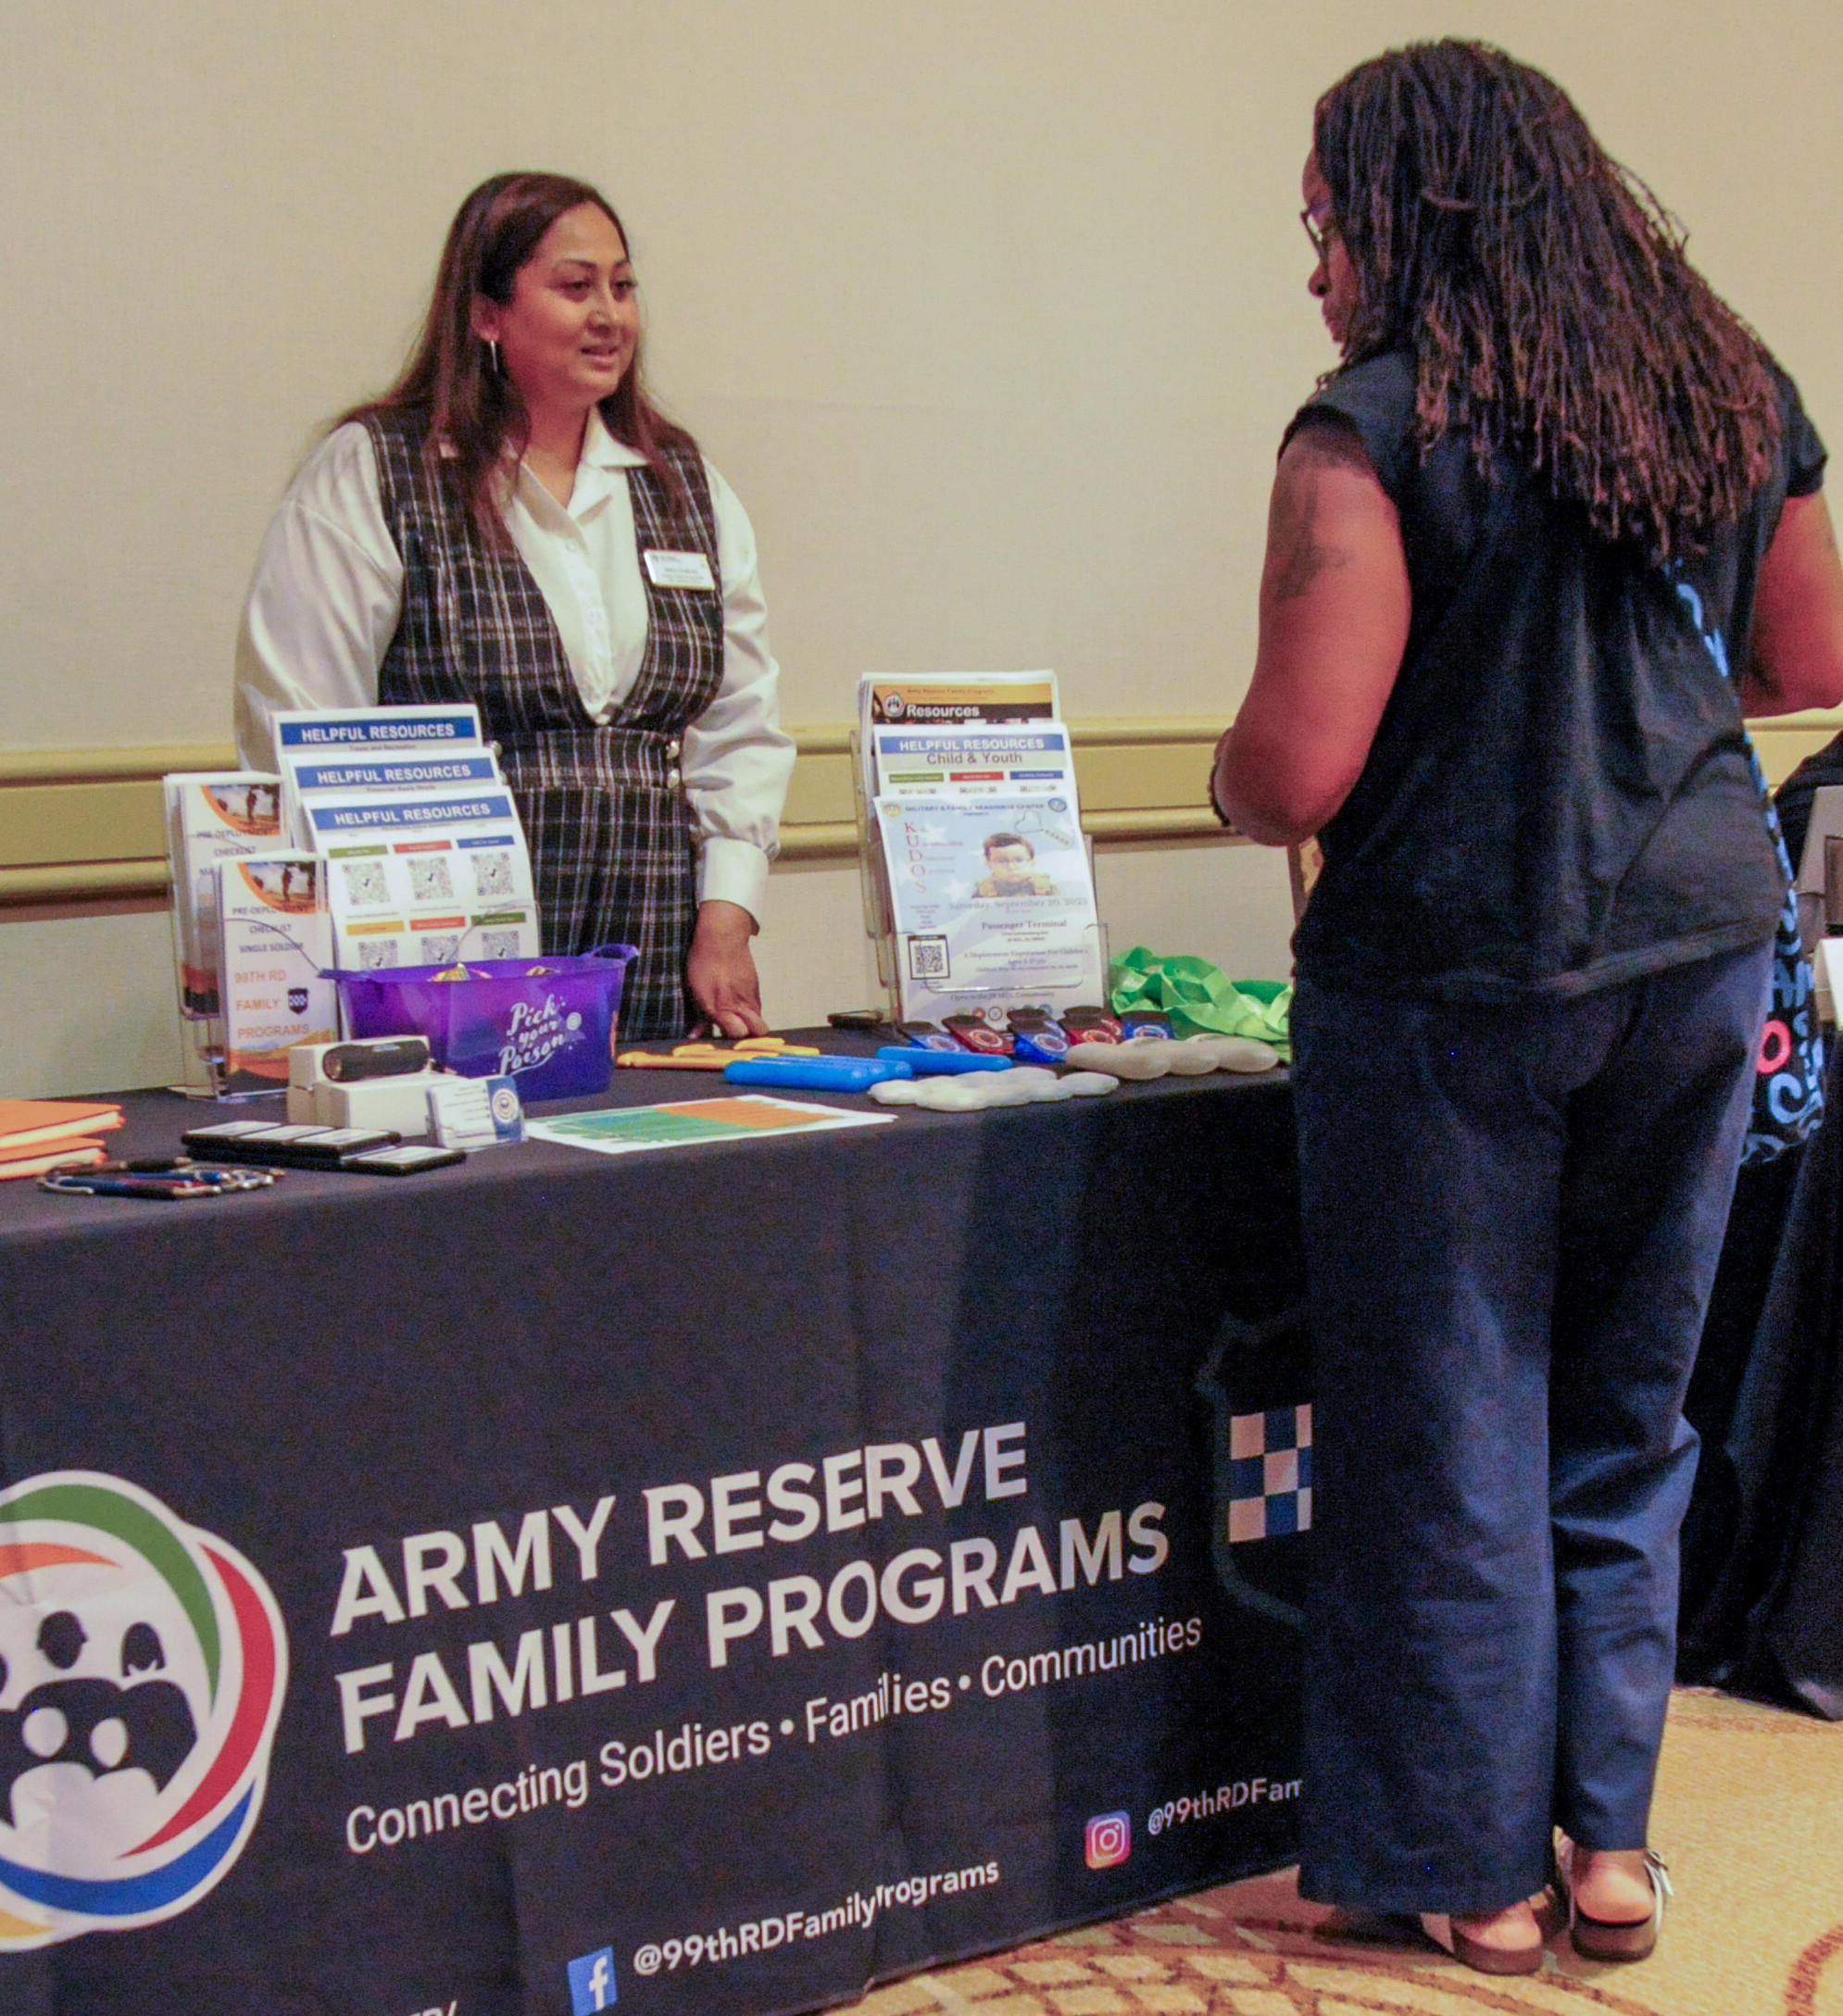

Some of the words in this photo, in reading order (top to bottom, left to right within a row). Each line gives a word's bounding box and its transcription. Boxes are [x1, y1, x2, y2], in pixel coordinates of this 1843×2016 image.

[907, 704, 980, 718] Resources
[301, 727, 367, 743] HELPFUL
[370, 723, 456, 740] RESOURCES
[899, 740, 960, 752] HELPFUL
[963, 738, 1045, 751] RESOURCES
[926, 753, 963, 765] Child
[967, 753, 977, 764] &
[983, 751, 1022, 764] Youth
[317, 770, 382, 784] HELPFUL
[385, 764, 472, 782] RESOURCES
[334, 811, 401, 826] HELPFUL
[404, 803, 491, 821] RESOURCES
[981, 920, 1024, 931] Passenger
[1026, 920, 1068, 929] Terminal
[239, 944, 268, 953] SINGLE
[234, 972, 266, 983] 99TH
[269, 970, 287, 982] RD
[236, 998, 281, 1011] FAMILY
[507, 993, 558, 1036] Pick
[237, 1023, 310, 1039] PROGRAMS
[519, 1021, 558, 1053] your
[498, 1033, 565, 1076] Poison
[330, 1495, 616, 1637] ARMY
[642, 1421, 1027, 1566] RESERVE
[334, 1599, 676, 1754] FAMILY
[706, 1501, 1169, 1669] PROGRAMS
[346, 1758, 589, 1854] Connecting
[599, 1721, 771, 1786] Soldiers
[806, 1672, 951, 1744] Families
[982, 1616, 1202, 1697] Communities
[633, 1860, 1000, 1976] @99thRDFamilyrograms
